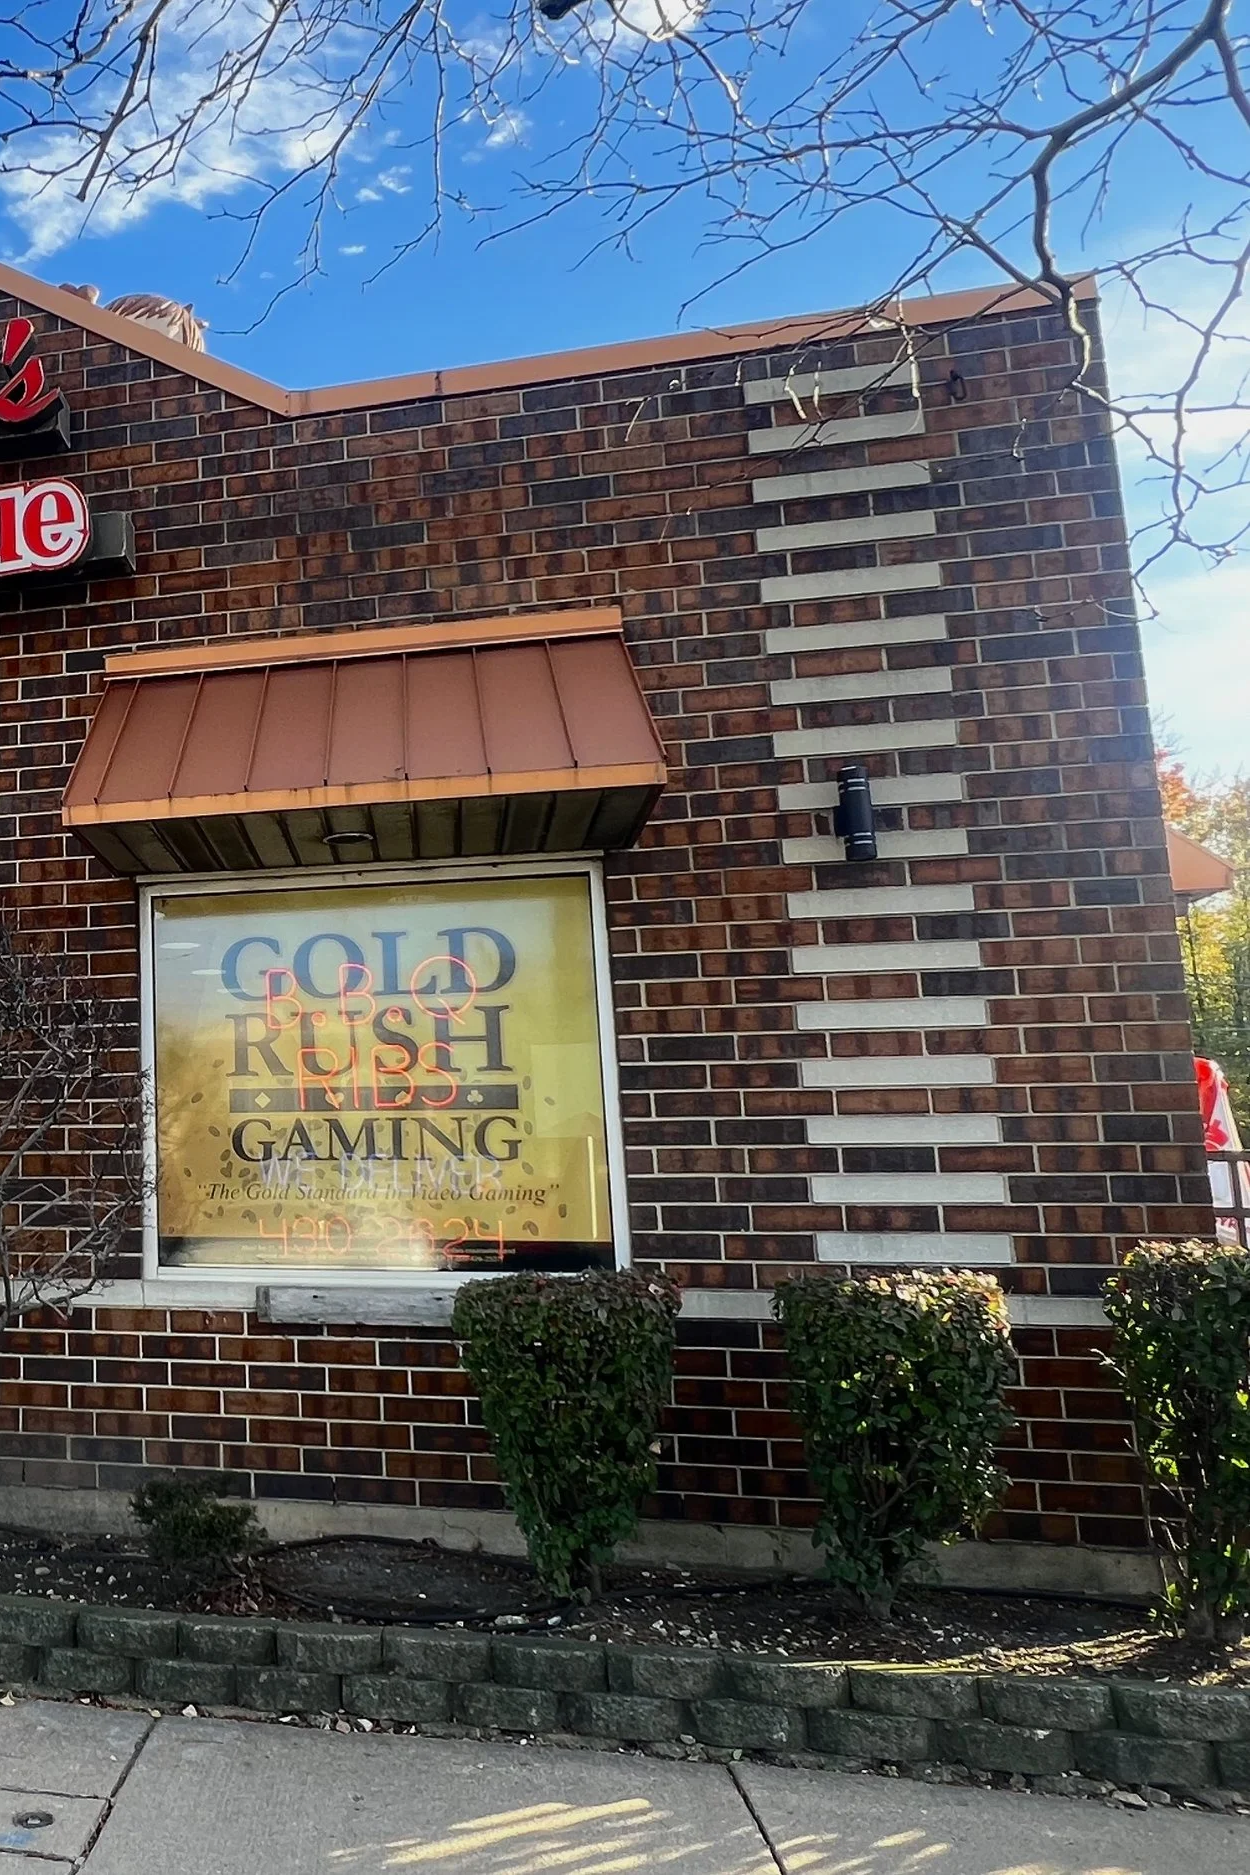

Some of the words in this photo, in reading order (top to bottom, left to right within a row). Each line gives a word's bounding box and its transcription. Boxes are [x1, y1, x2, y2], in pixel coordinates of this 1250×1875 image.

[220, 926, 516, 1001] GOLD
[224, 1004, 514, 1078] RUSH
[297, 1041, 460, 1110] RIBS
[231, 1115, 523, 1163] GAMING
[246, 1183, 291, 1200] Gold
[295, 1182, 378, 1200] Standard
[410, 1182, 461, 1200] Video
[259, 1151, 317, 1190] WE
[338, 1152, 502, 1196] DELIVER
